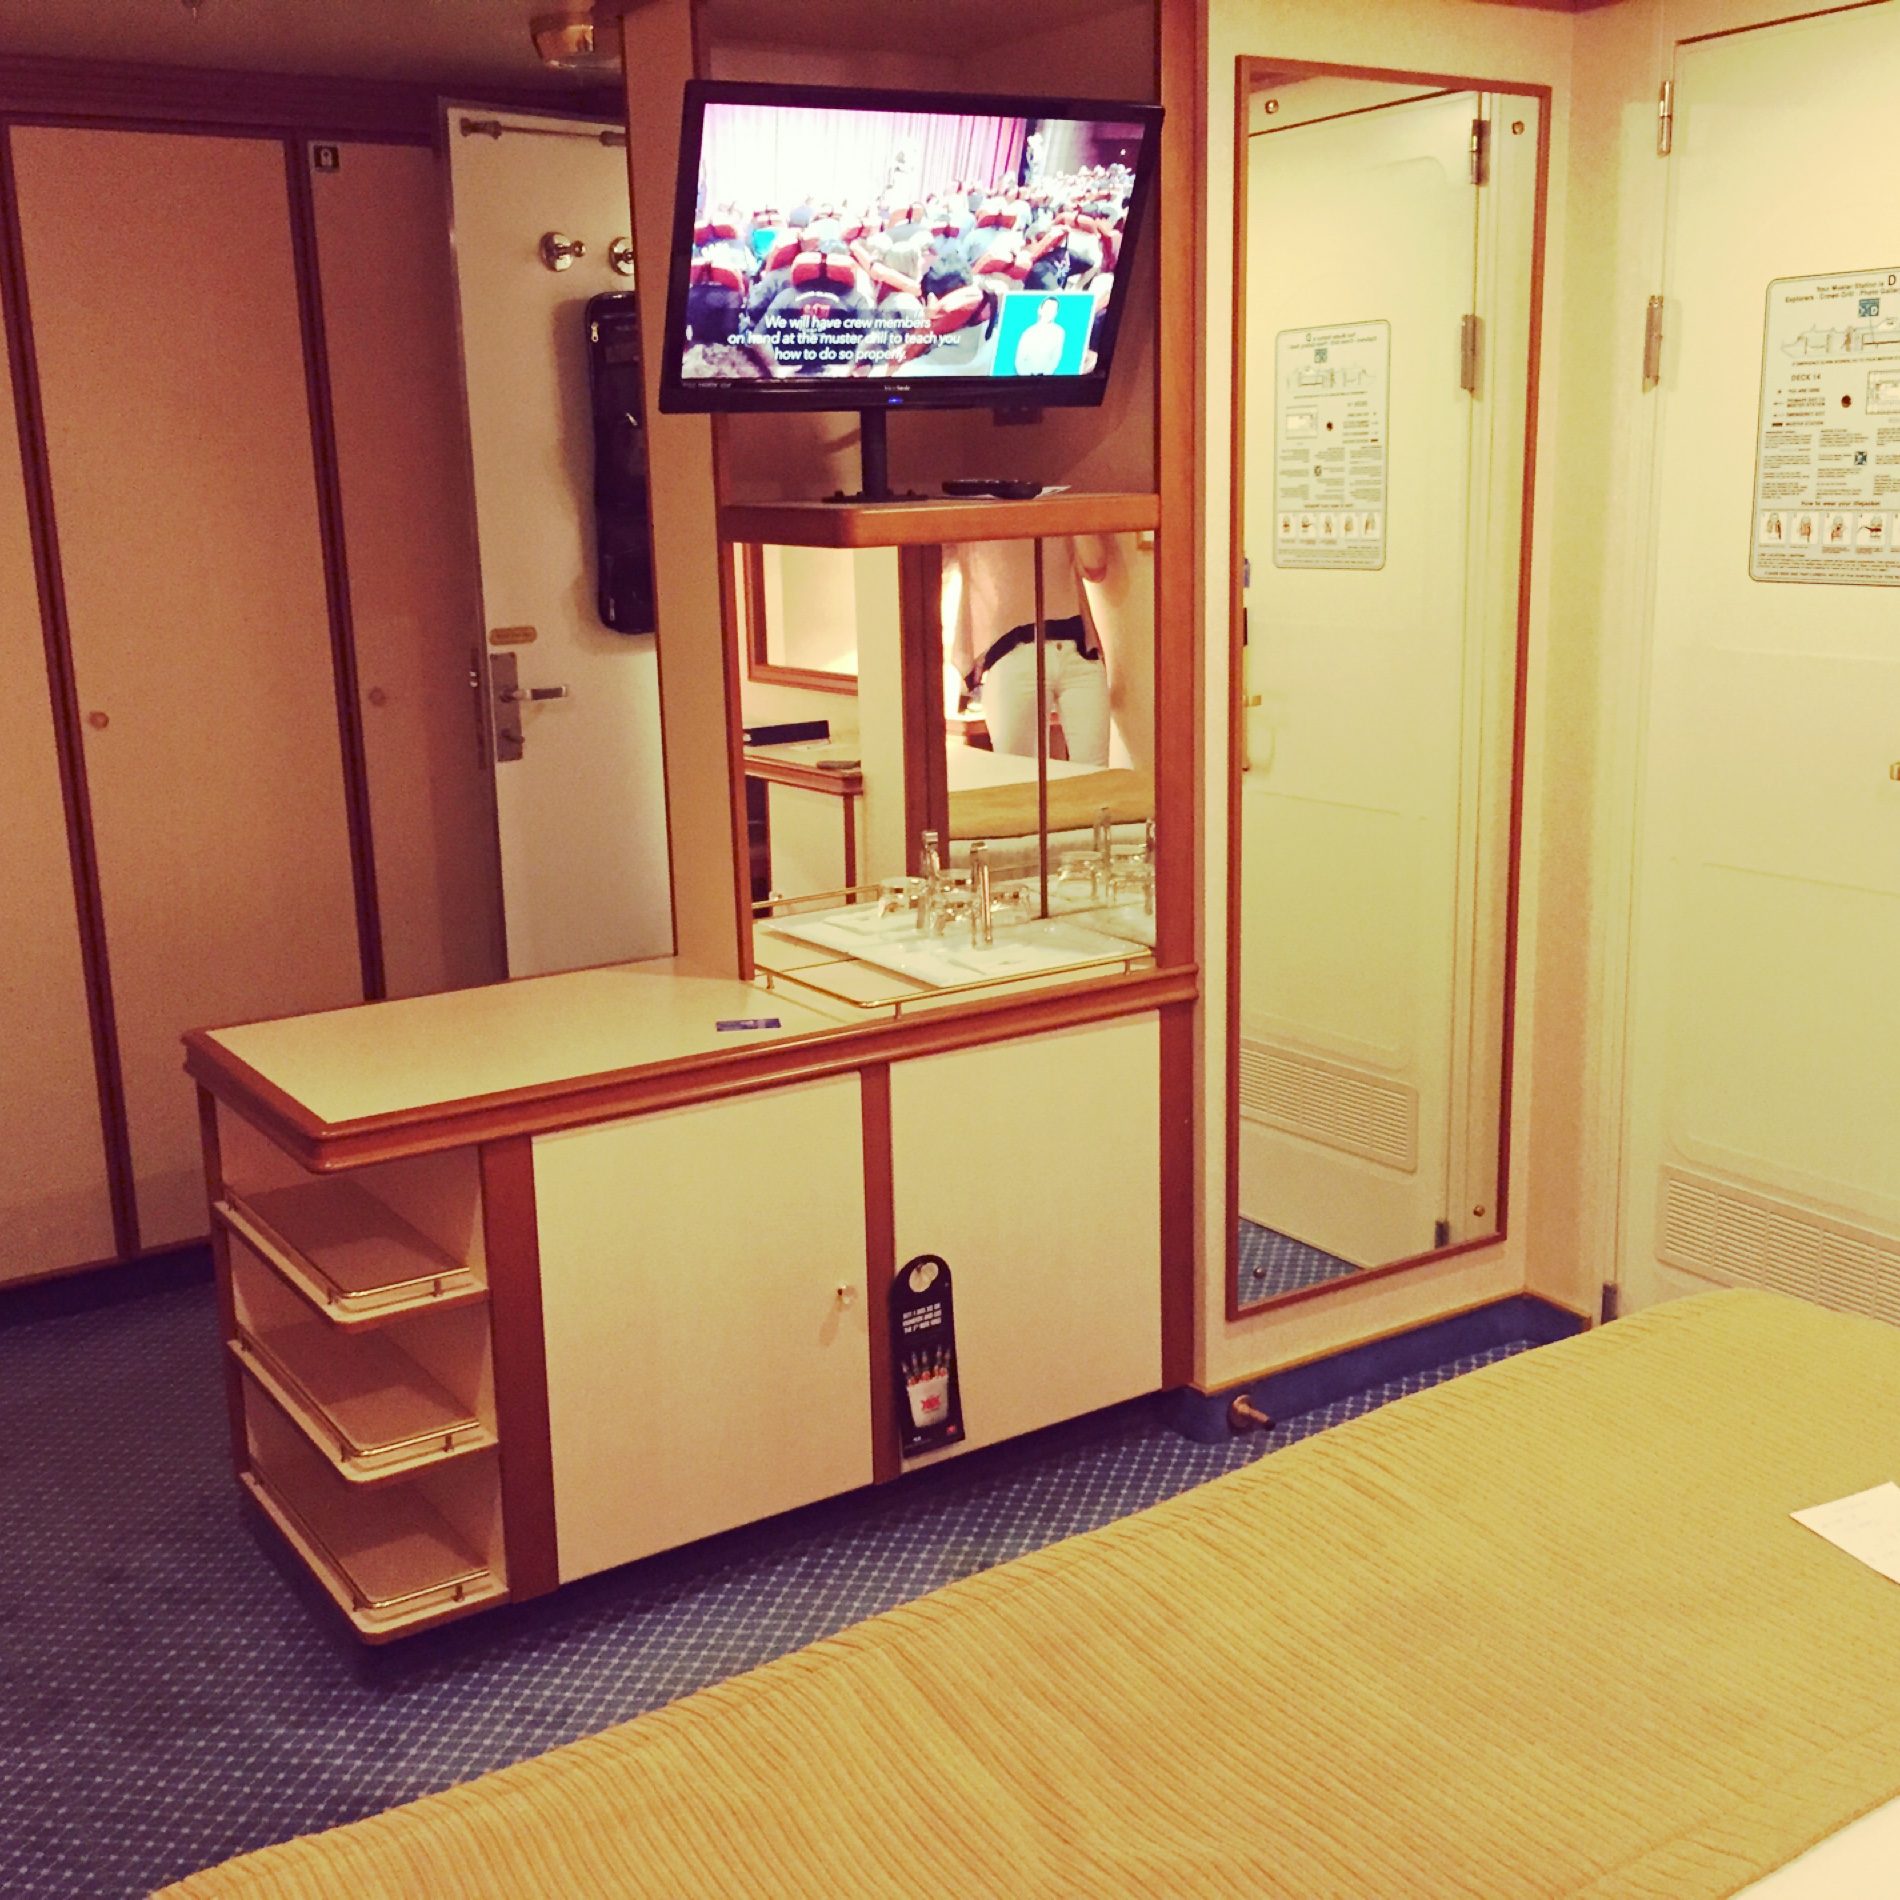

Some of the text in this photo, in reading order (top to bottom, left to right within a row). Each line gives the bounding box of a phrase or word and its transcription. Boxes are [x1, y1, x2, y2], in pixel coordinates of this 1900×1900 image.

[1888, 274, 1897, 286] D
[765, 315, 932, 329] We will have crew members
[727, 330, 961, 348] on hand at the muster drill to teach you
[775, 346, 907, 363] how to do so properly.
